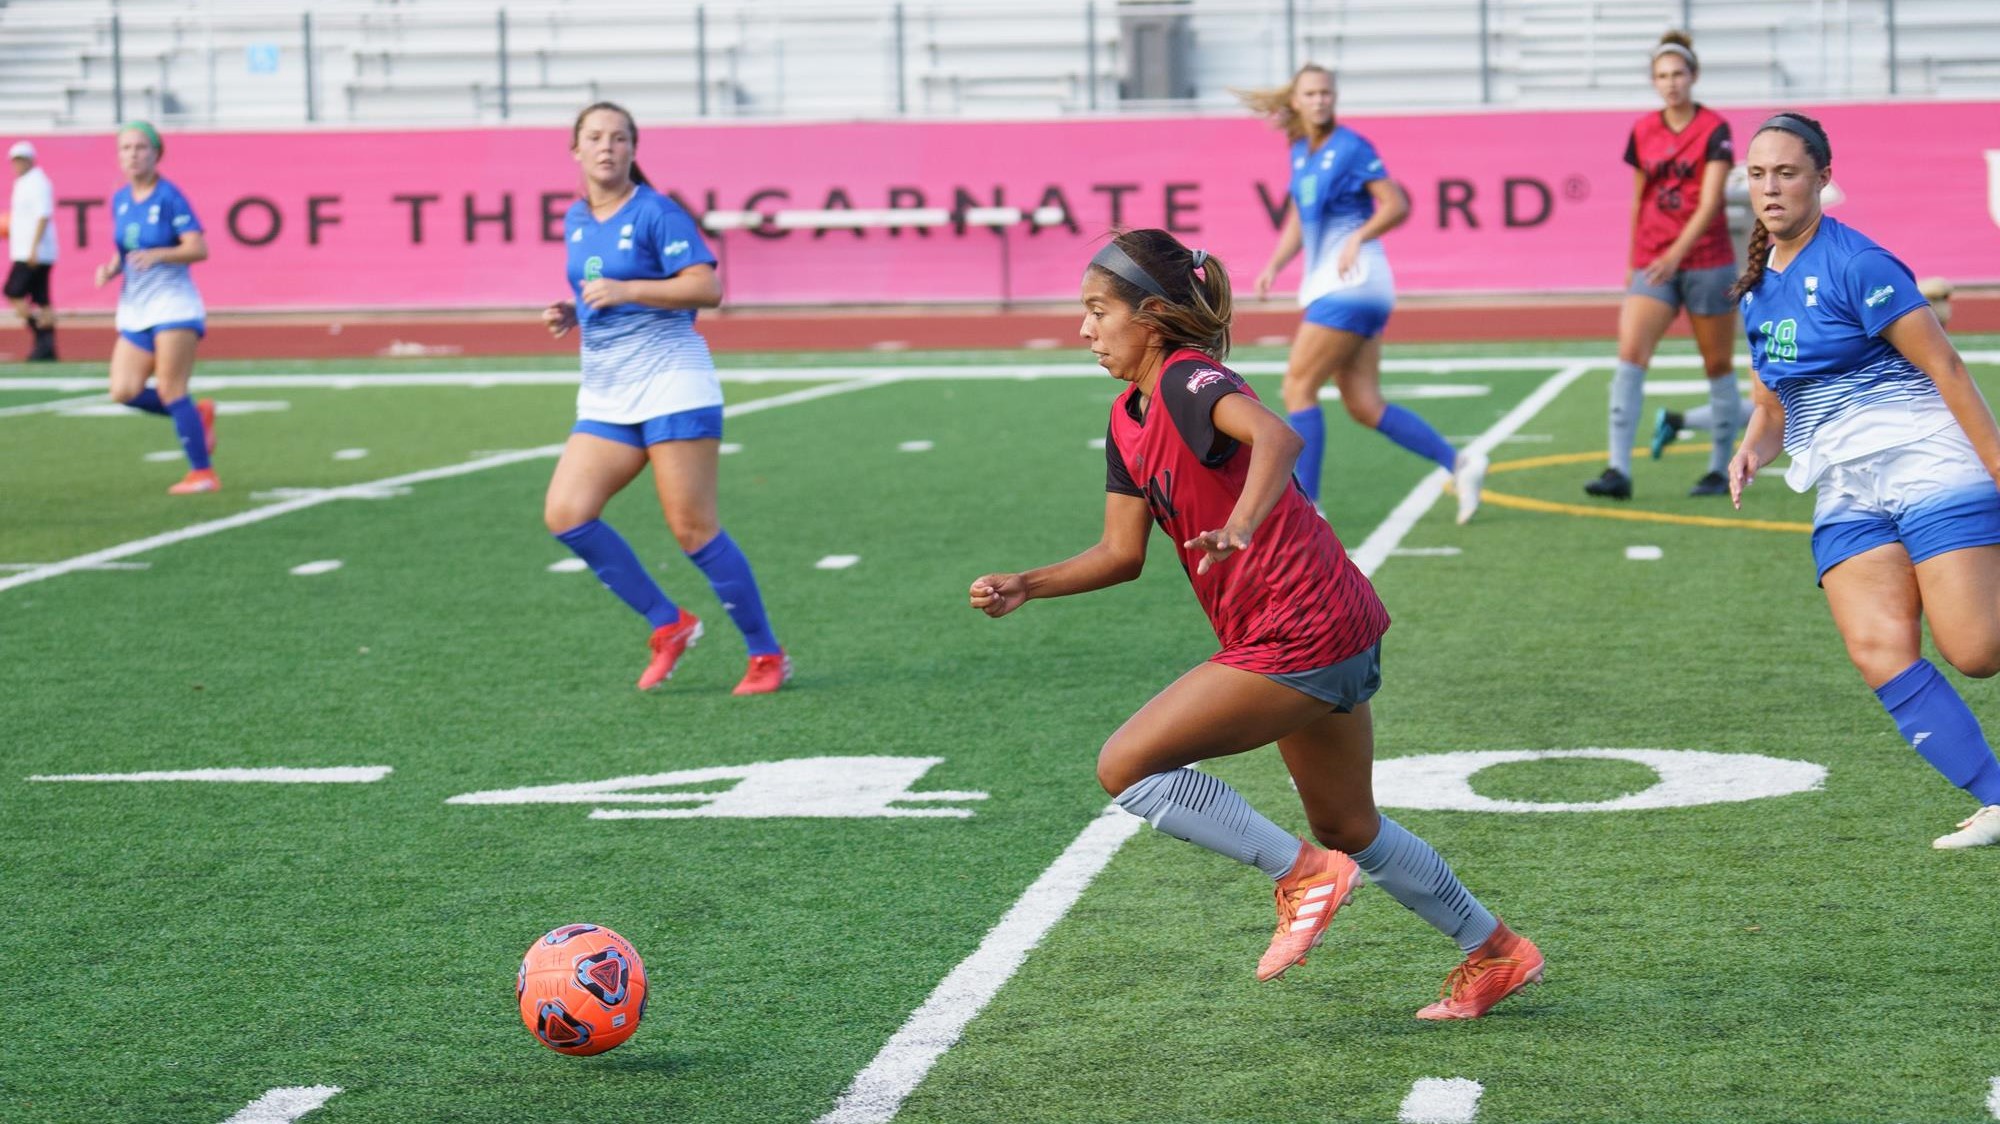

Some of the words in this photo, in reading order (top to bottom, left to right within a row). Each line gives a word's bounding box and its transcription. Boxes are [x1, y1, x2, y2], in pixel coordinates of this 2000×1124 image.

[226, 194, 342, 248] OF
[393, 192, 575, 244] THE
[669, 184, 1203, 239] NCARNATE
[1759, 318, 1799, 364] 18
